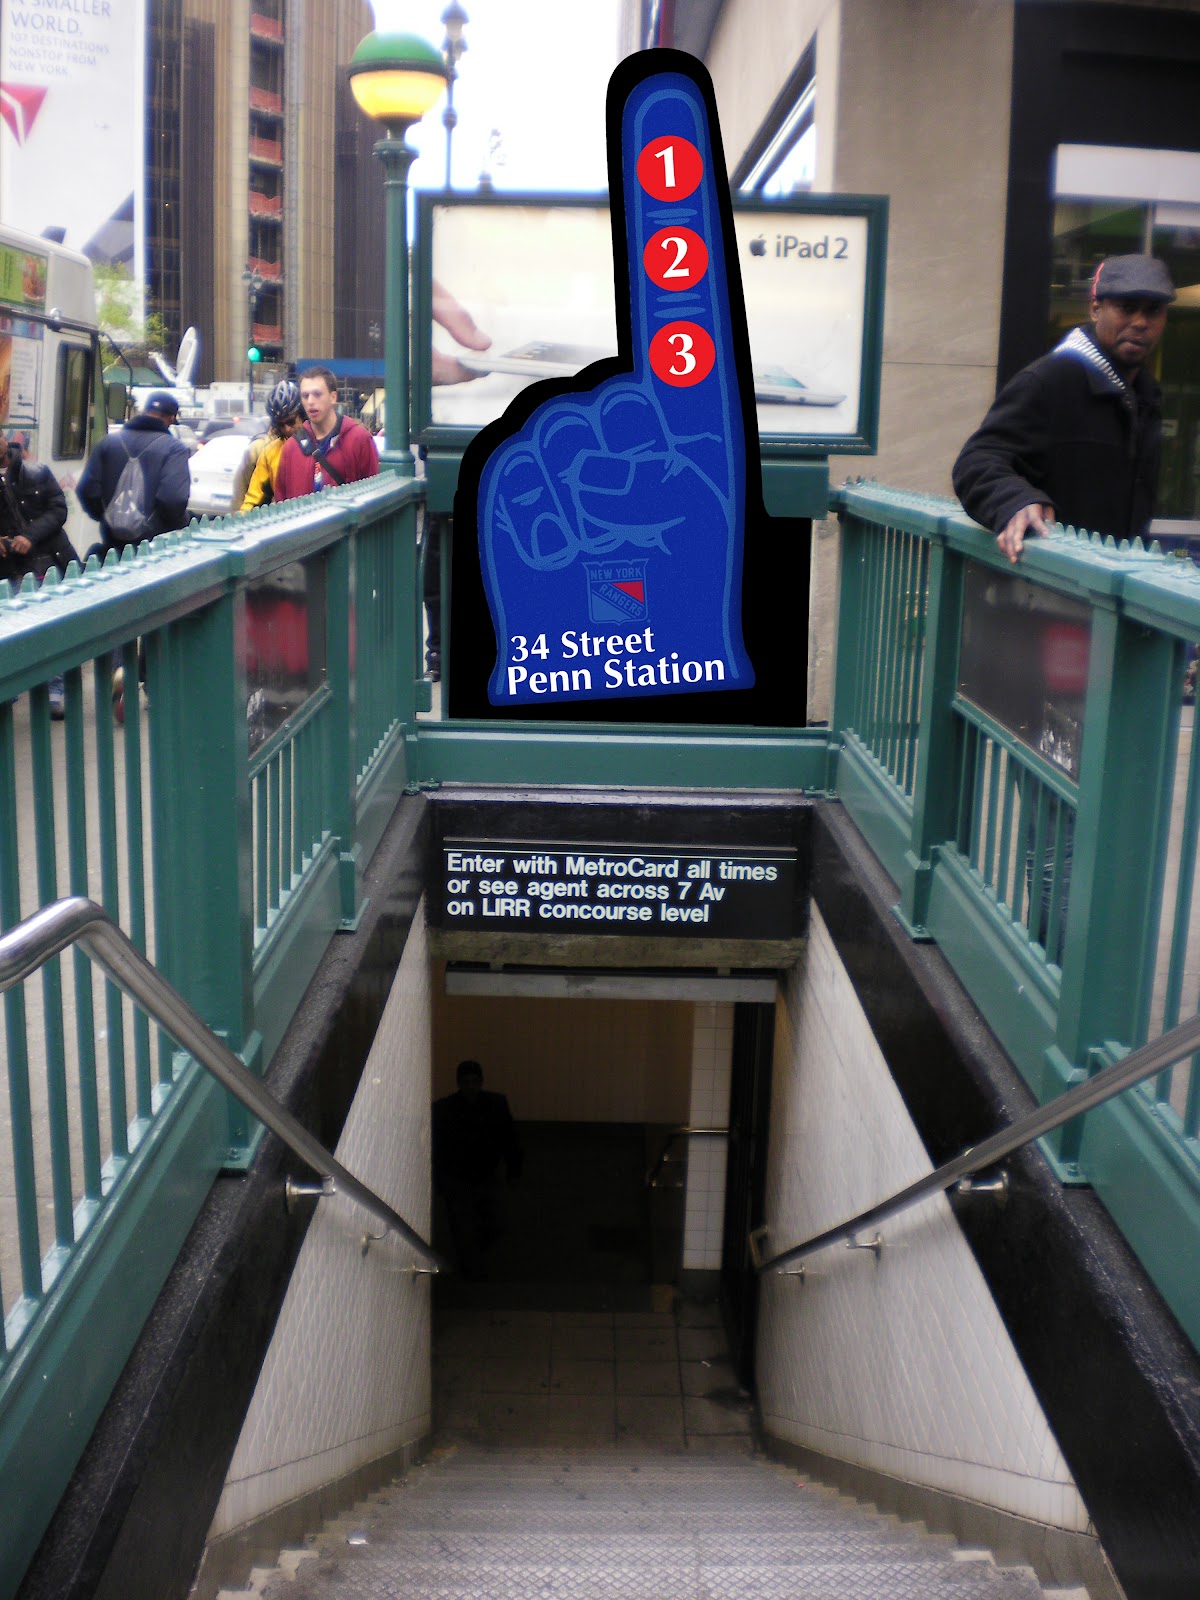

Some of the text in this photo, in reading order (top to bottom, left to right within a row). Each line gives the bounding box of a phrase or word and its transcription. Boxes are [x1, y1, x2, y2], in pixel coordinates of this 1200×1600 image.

[31, 33, 110, 54] DESTINATIONS
[9, 46, 96, 66] NONSTOP FROM
[9, 60, 35, 72] NEW
[776, 233, 848, 259] iPad 2
[447, 852, 778, 881] Enter with MetroCard all times
[447, 878, 726, 901] or see agent across 7 Av
[446, 898, 709, 923] on LIRR concourse level
